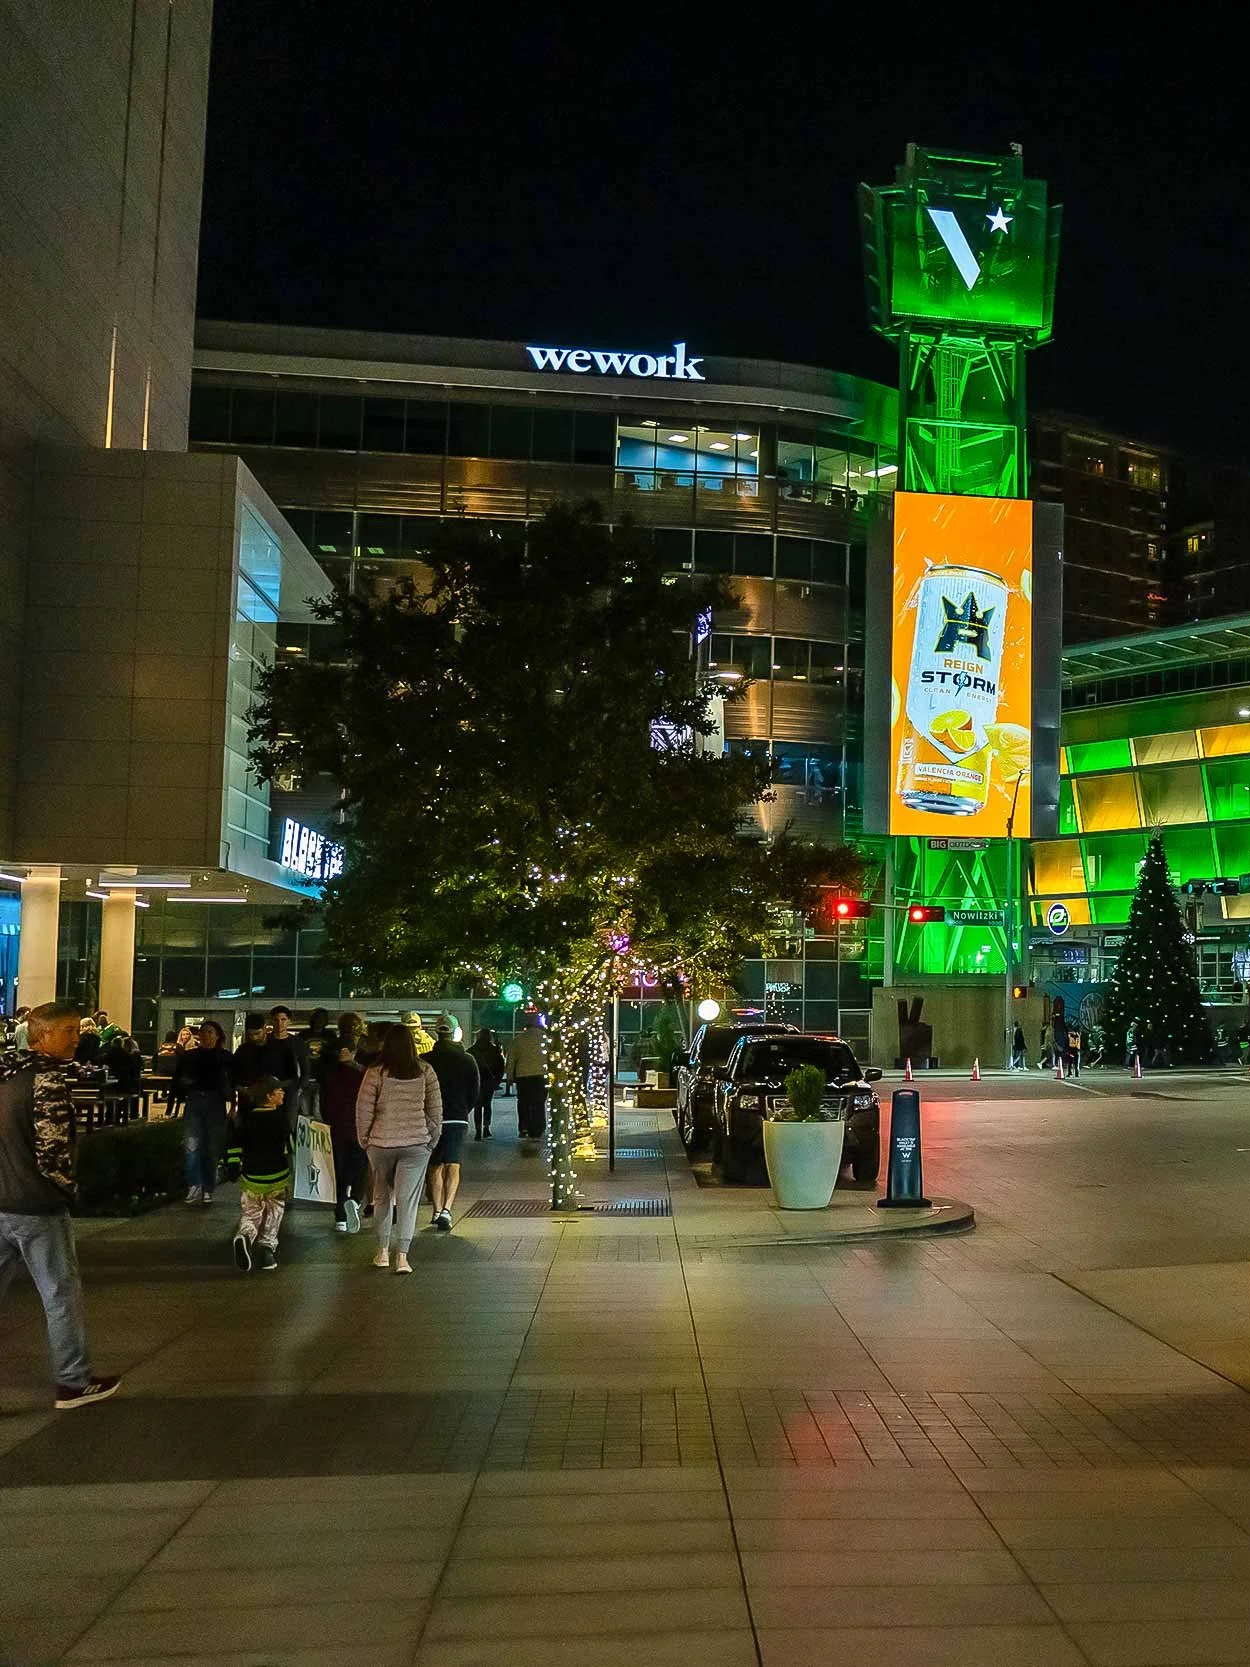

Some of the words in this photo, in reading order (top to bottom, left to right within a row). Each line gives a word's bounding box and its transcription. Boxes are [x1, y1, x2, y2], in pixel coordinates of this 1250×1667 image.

[526, 342, 706, 380] wework
[943, 658, 984, 675] REIGN
[920, 670, 996, 697] STORM
[918, 766, 955, 777] VALENCIA
[955, 770, 982, 782] ORANGE
[930, 840, 947, 849] BIG
[952, 910, 998, 921] Nowitzki
